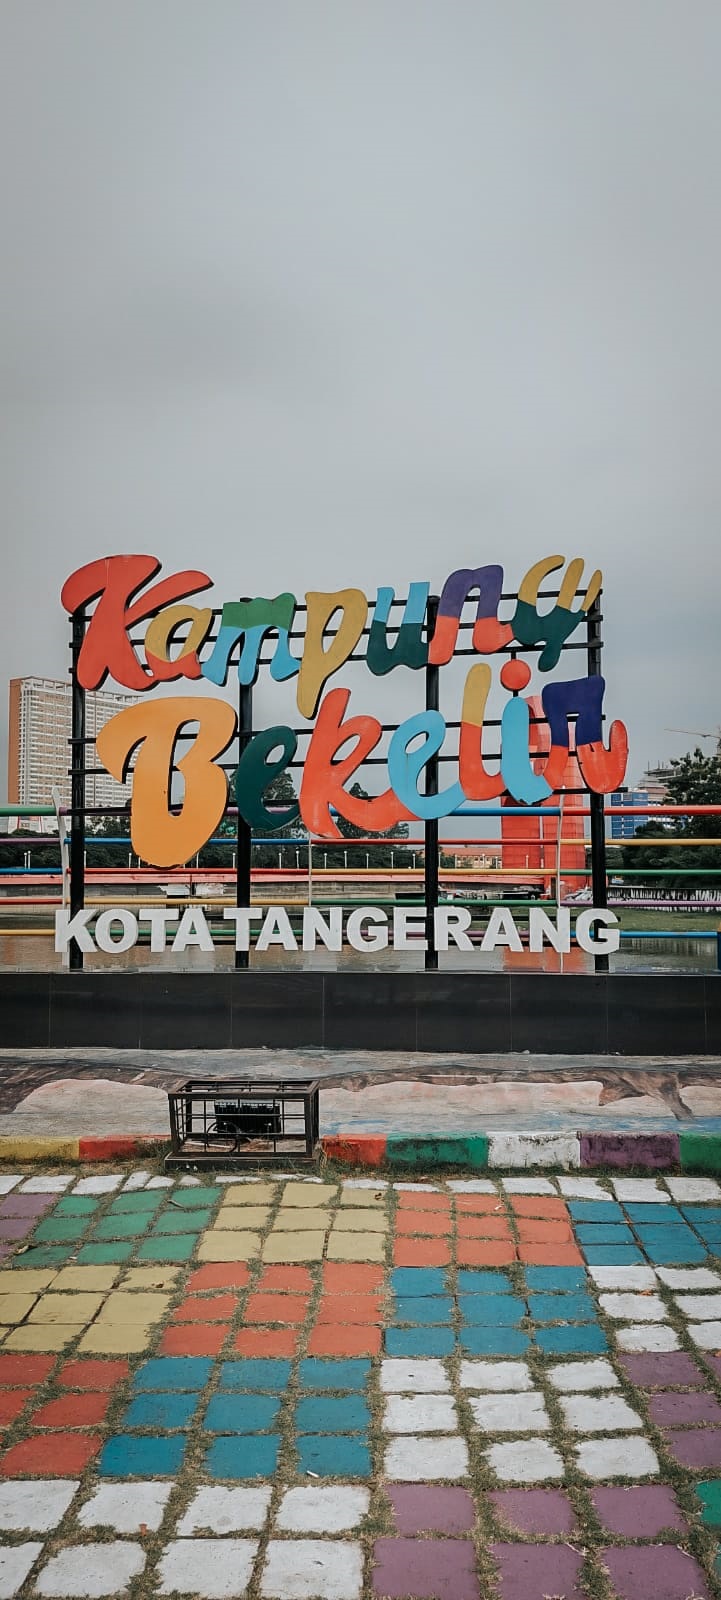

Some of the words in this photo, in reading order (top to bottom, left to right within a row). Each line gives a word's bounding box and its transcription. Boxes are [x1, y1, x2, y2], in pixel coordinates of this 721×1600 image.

[61, 554, 603, 718] Kampung
[55, 907, 215, 953] KOTA
[223, 907, 621, 955] TANGERANG
